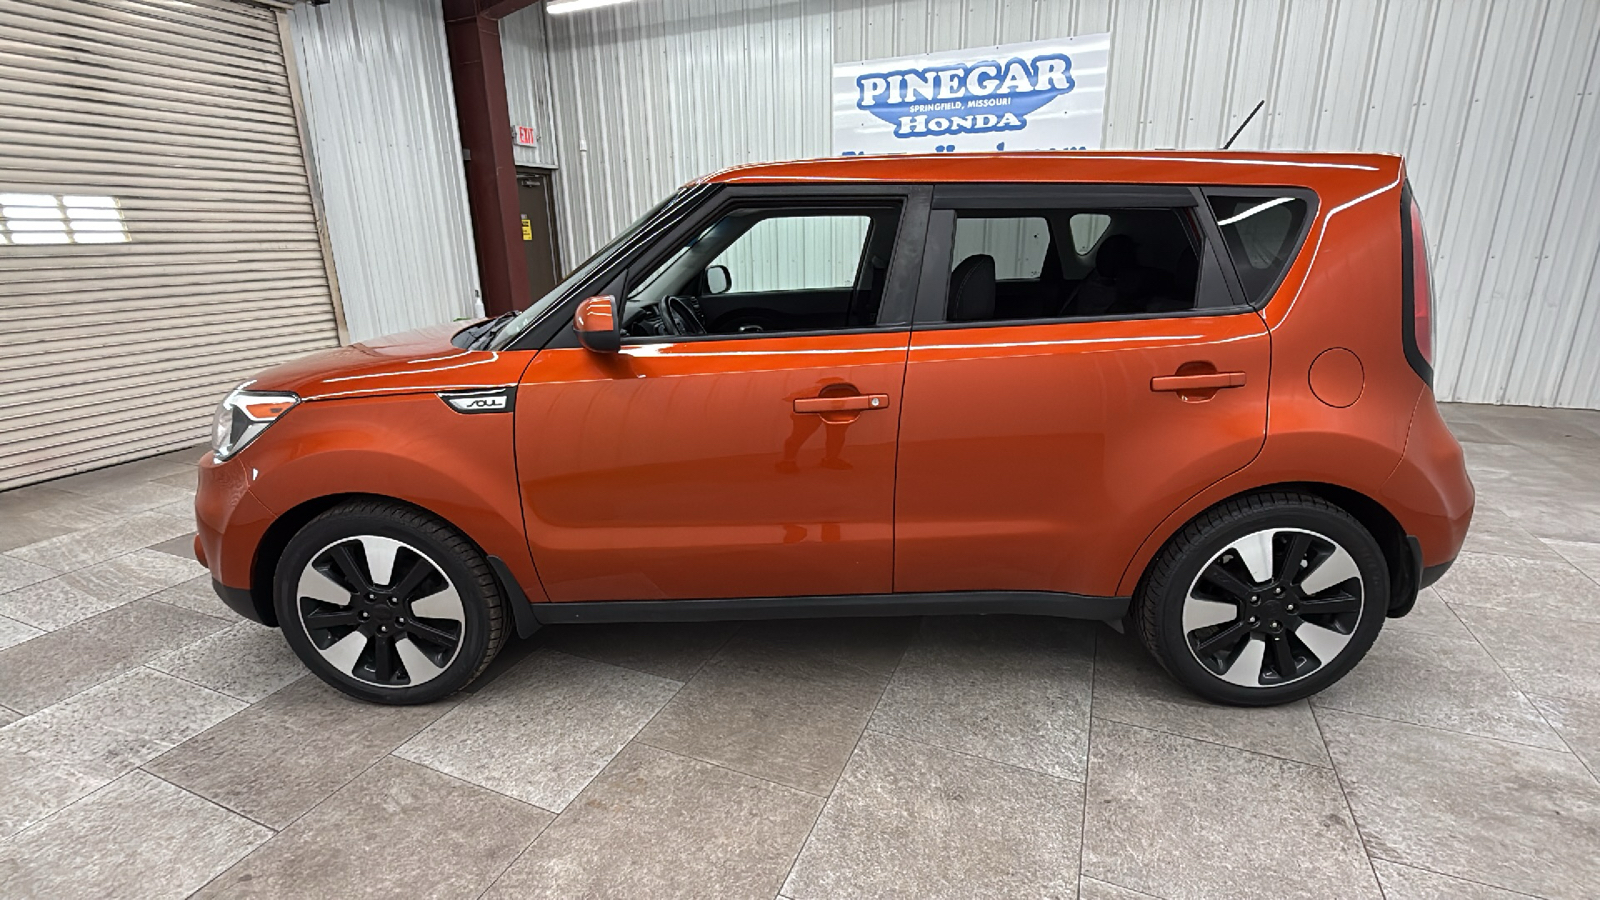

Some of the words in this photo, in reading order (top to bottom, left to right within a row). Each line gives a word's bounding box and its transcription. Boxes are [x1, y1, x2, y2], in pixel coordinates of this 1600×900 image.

[860, 58, 1070, 107] PINEGAR
[909, 101, 965, 113] SPRINGFIELD,
[967, 97, 1012, 109] MISSOURI
[519, 126, 534, 144] EXIT
[466, 399, 503, 408] SOUL
